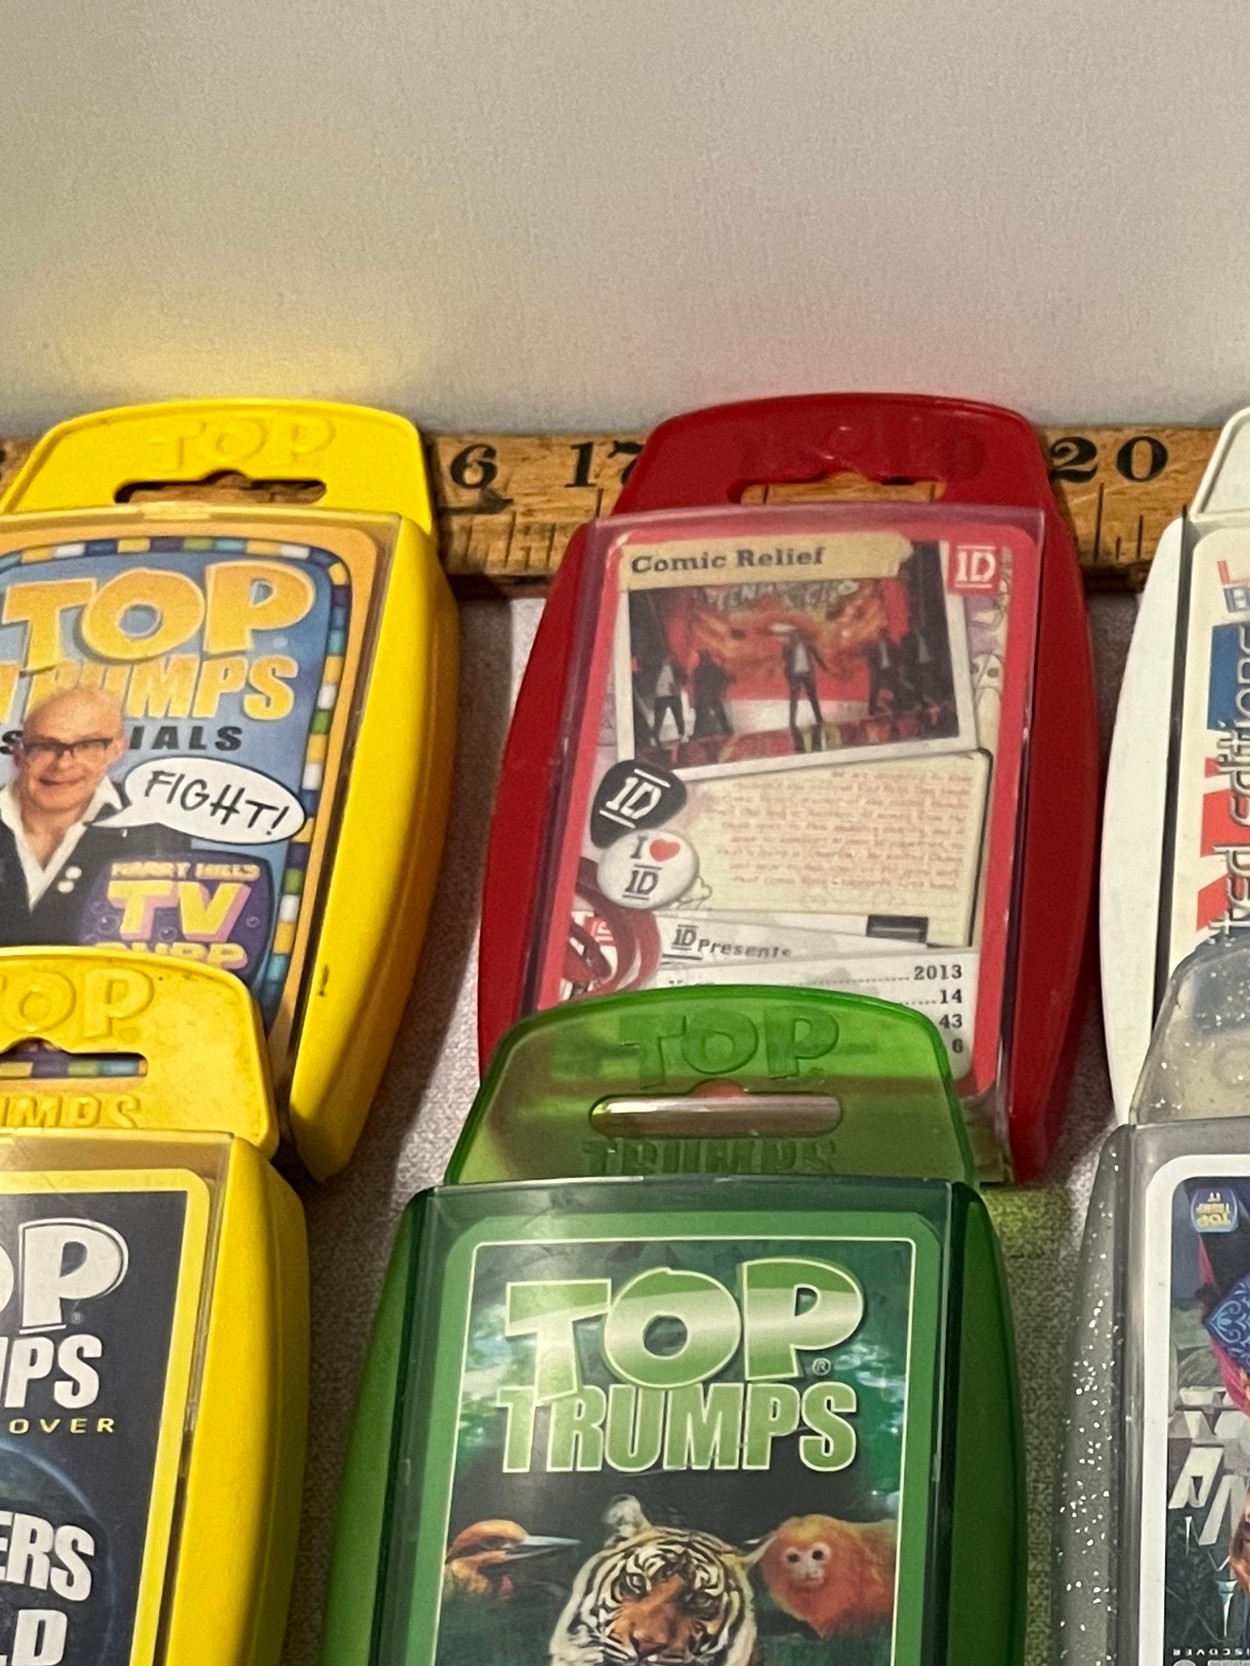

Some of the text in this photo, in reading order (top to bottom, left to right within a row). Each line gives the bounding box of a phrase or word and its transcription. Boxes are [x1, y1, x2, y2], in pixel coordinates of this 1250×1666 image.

[149, 415, 337, 471] TOP
[1050, 435, 1168, 484] 20
[630, 546, 827, 574] Comic Relief
[2, 559, 316, 673] TOP
[1, 725, 243, 755] SIALS
[144, 770, 290, 836] FIGHT!
[107, 879, 252, 943] TV
[913, 964, 963, 981] 2013
[939, 989, 963, 1005] 14
[0, 967, 154, 1038] OP
[938, 1014, 963, 1030] 43
[619, 1005, 840, 1089] TOP
[951, 1038, 964, 1054] 6
[0, 1094, 140, 1129] MPS
[505, 1257, 865, 1402] TOP
[0, 1332, 103, 1410] PS
[497, 1381, 858, 1473] TRUMPS
